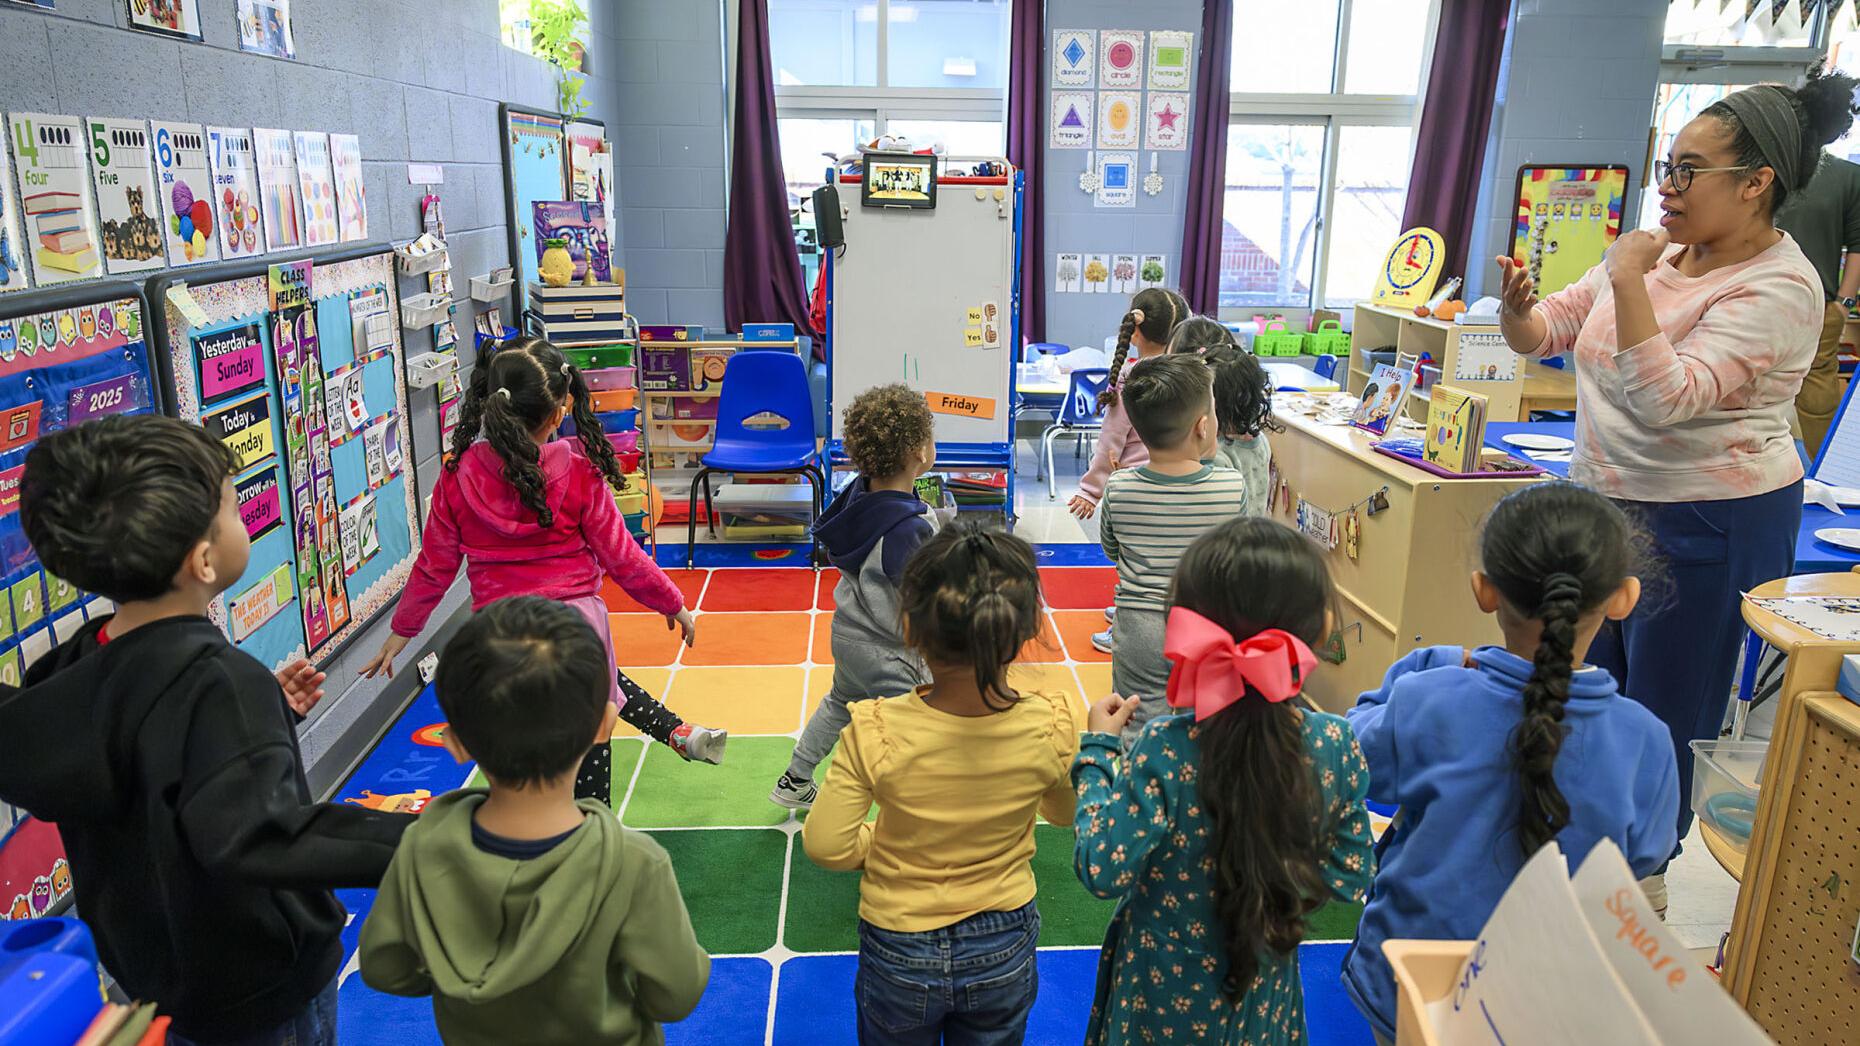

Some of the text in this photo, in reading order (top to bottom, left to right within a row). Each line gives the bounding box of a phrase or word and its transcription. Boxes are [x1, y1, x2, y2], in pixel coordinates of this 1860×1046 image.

[15, 120, 38, 167] 4
[90, 123, 110, 167] 5
[1058, 132, 1084, 140] triangle
[157, 128, 172, 168] 6
[210, 132, 221, 169] 7
[25, 170, 48, 186] four
[100, 171, 119, 186] five
[162, 170, 174, 183] six
[215, 174, 235, 185] seven
[280, 268, 305, 284] CLASS
[275, 286, 309, 304] HELPERS
[200, 333, 246, 359] Yesterday
[217, 357, 254, 382] Sunday
[1380, 367, 1402, 383] I Help
[89, 386, 123, 412] 2025
[346, 377, 359, 399] Aa
[941, 397, 979, 413] Friday
[221, 410, 249, 433] Today
[238, 482, 262, 504] orrow
[23, 589, 35, 612] 4
[233, 581, 273, 621] THE WEATHER
[1605, 888, 1687, 992] Square
